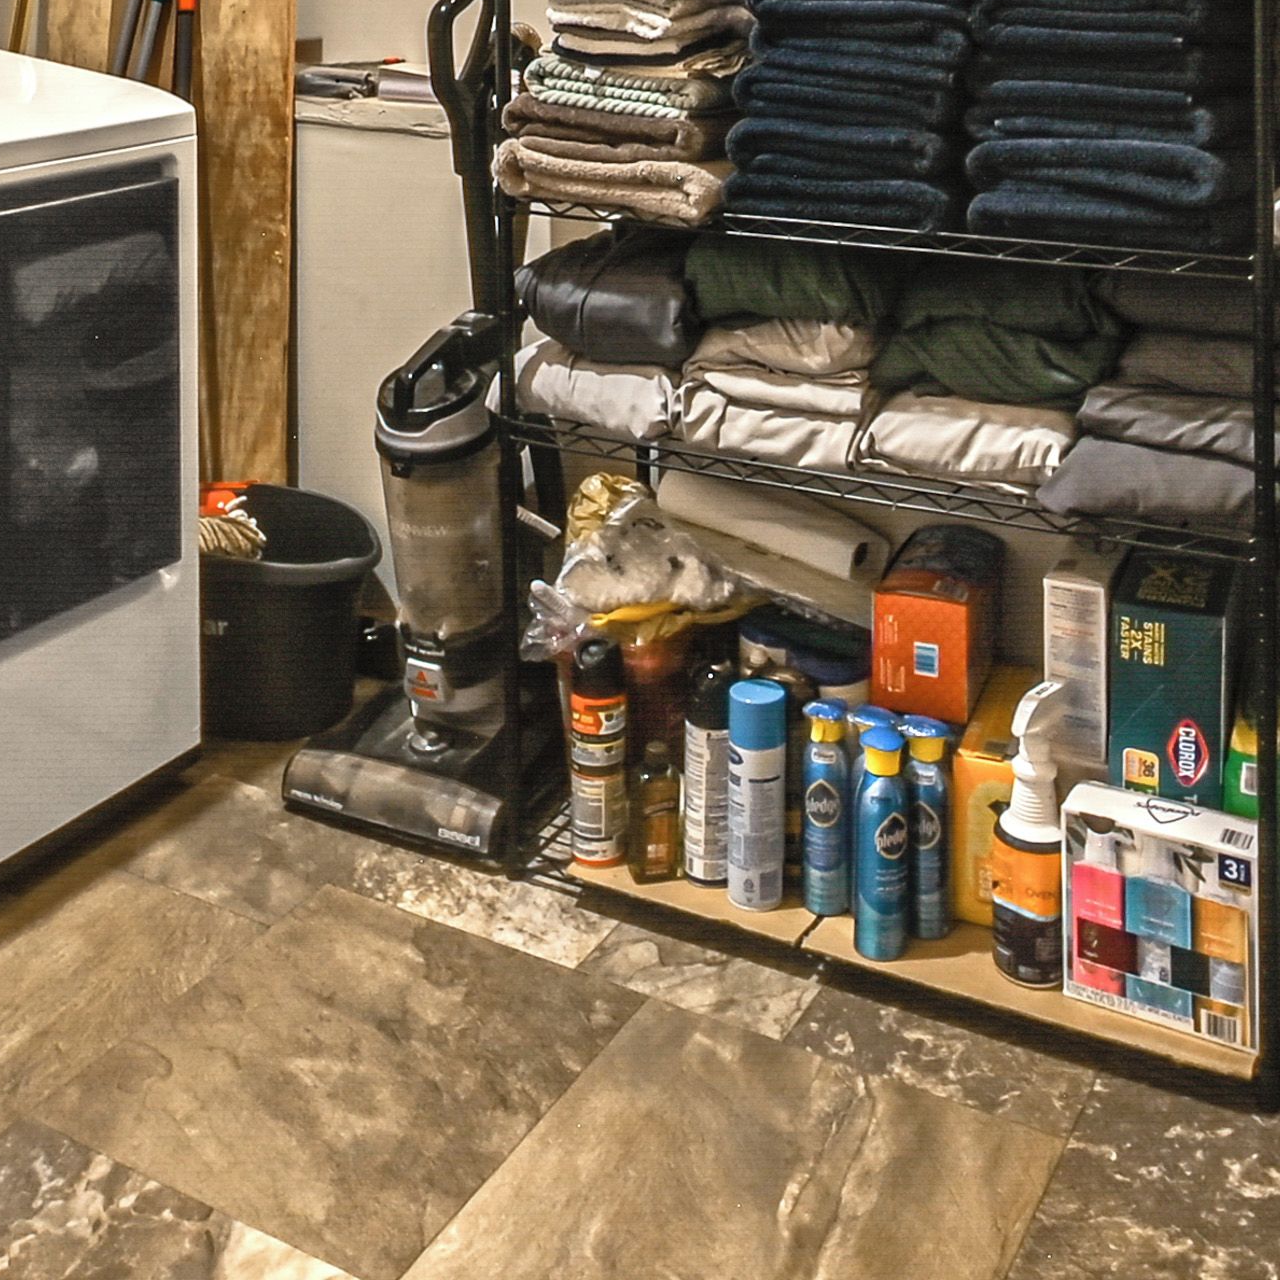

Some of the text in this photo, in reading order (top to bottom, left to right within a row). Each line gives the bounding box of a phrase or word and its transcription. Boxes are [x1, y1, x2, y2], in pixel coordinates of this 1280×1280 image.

[1120, 616, 1131, 661] FASTER
[1130, 629, 1143, 650] 2X
[1143, 621, 1154, 665] STAINS
[1178, 726, 1197, 779] CLOROX
[1223, 859, 1239, 879] 3
